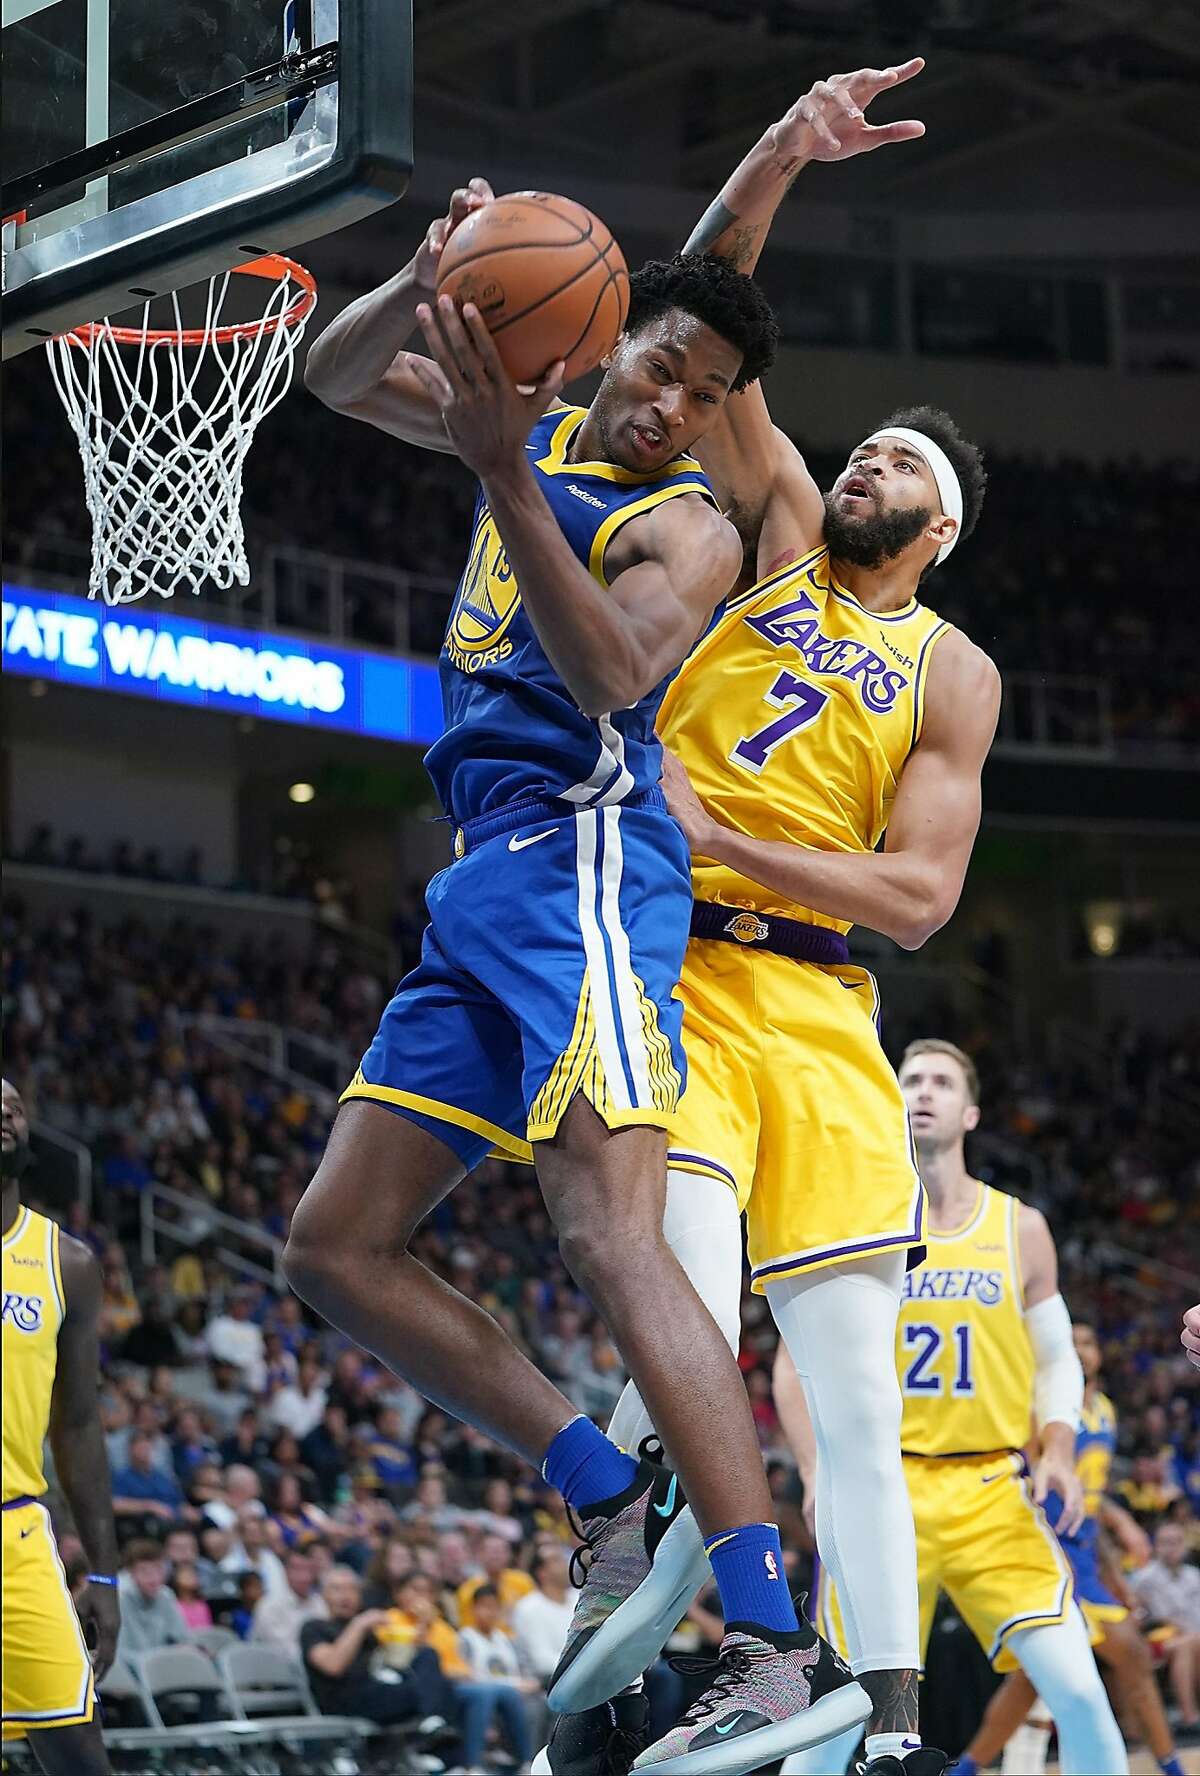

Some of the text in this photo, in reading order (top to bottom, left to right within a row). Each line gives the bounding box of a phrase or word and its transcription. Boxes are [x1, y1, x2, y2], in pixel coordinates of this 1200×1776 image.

[103, 621, 345, 713] WARRIORS
[742, 589, 909, 715] LAKERS
[879, 630, 914, 670] wish
[728, 667, 832, 775] 7
[724, 917, 769, 940] LAKERS
[904, 1323, 975, 1394] 21
